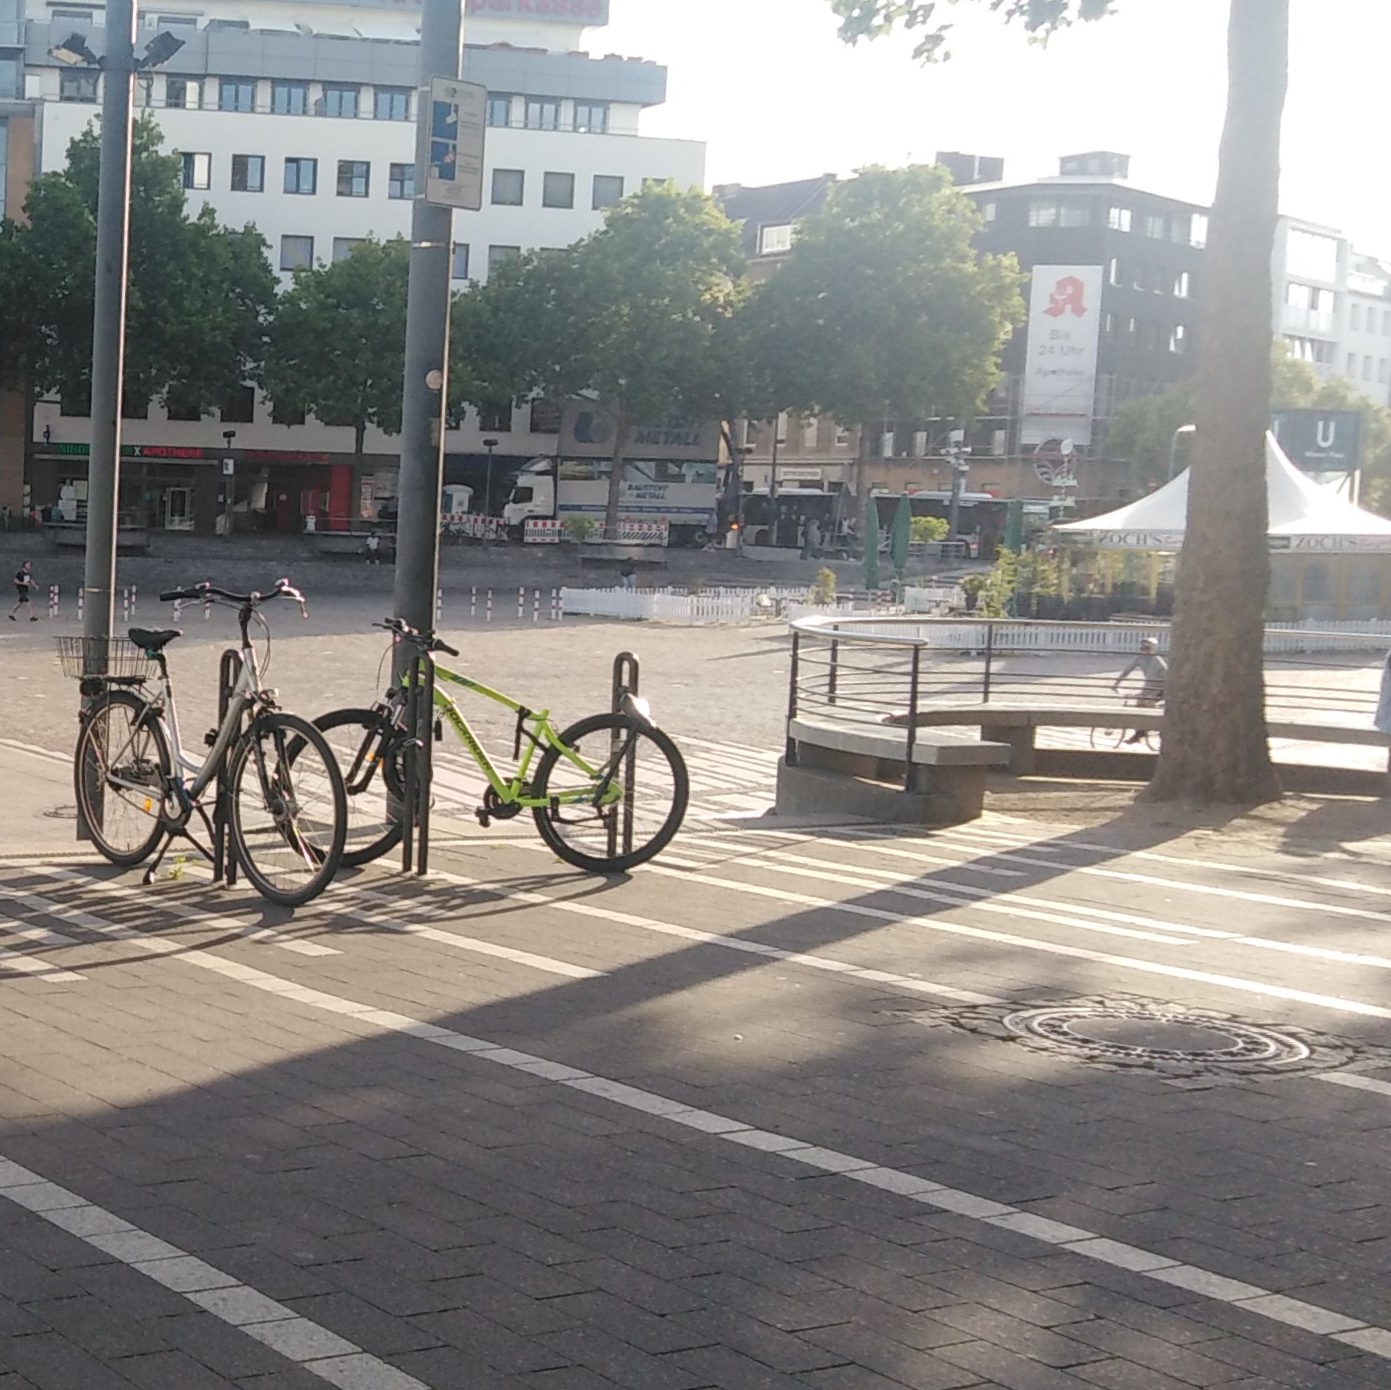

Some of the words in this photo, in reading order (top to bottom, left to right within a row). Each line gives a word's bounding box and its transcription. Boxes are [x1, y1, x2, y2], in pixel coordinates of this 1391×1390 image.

[1050, 329, 1071, 340] Bis
[1038, 345, 1055, 356] 24
[1060, 345, 1085, 356] Uhr
[1317, 420, 1335, 448] U
